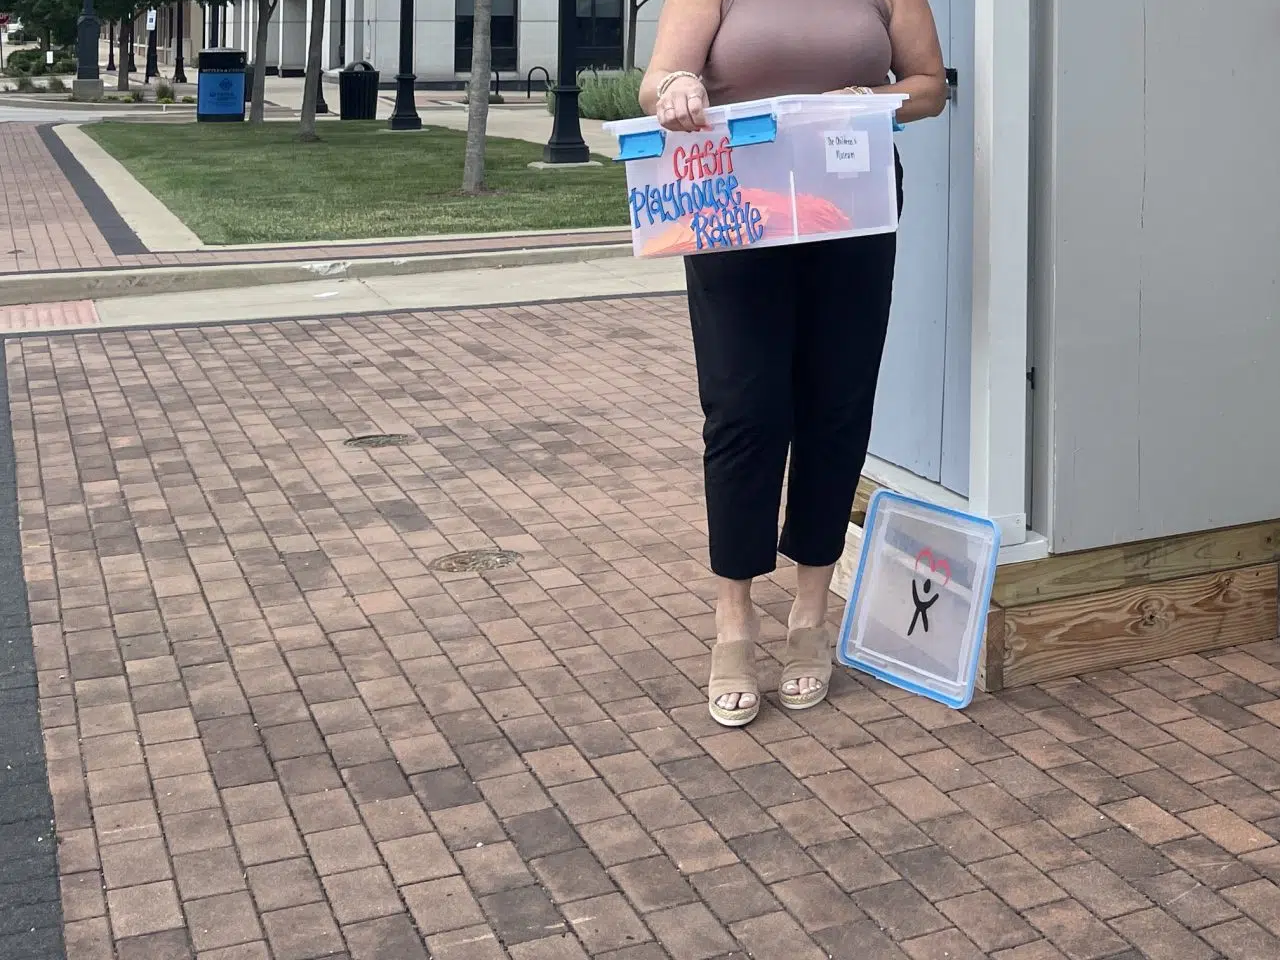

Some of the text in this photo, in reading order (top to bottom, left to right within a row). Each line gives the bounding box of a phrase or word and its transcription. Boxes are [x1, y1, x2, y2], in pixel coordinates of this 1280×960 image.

[674, 137, 733, 180] CASA
[629, 176, 741, 229] Playhouse
[690, 202, 763, 250] Raffle
